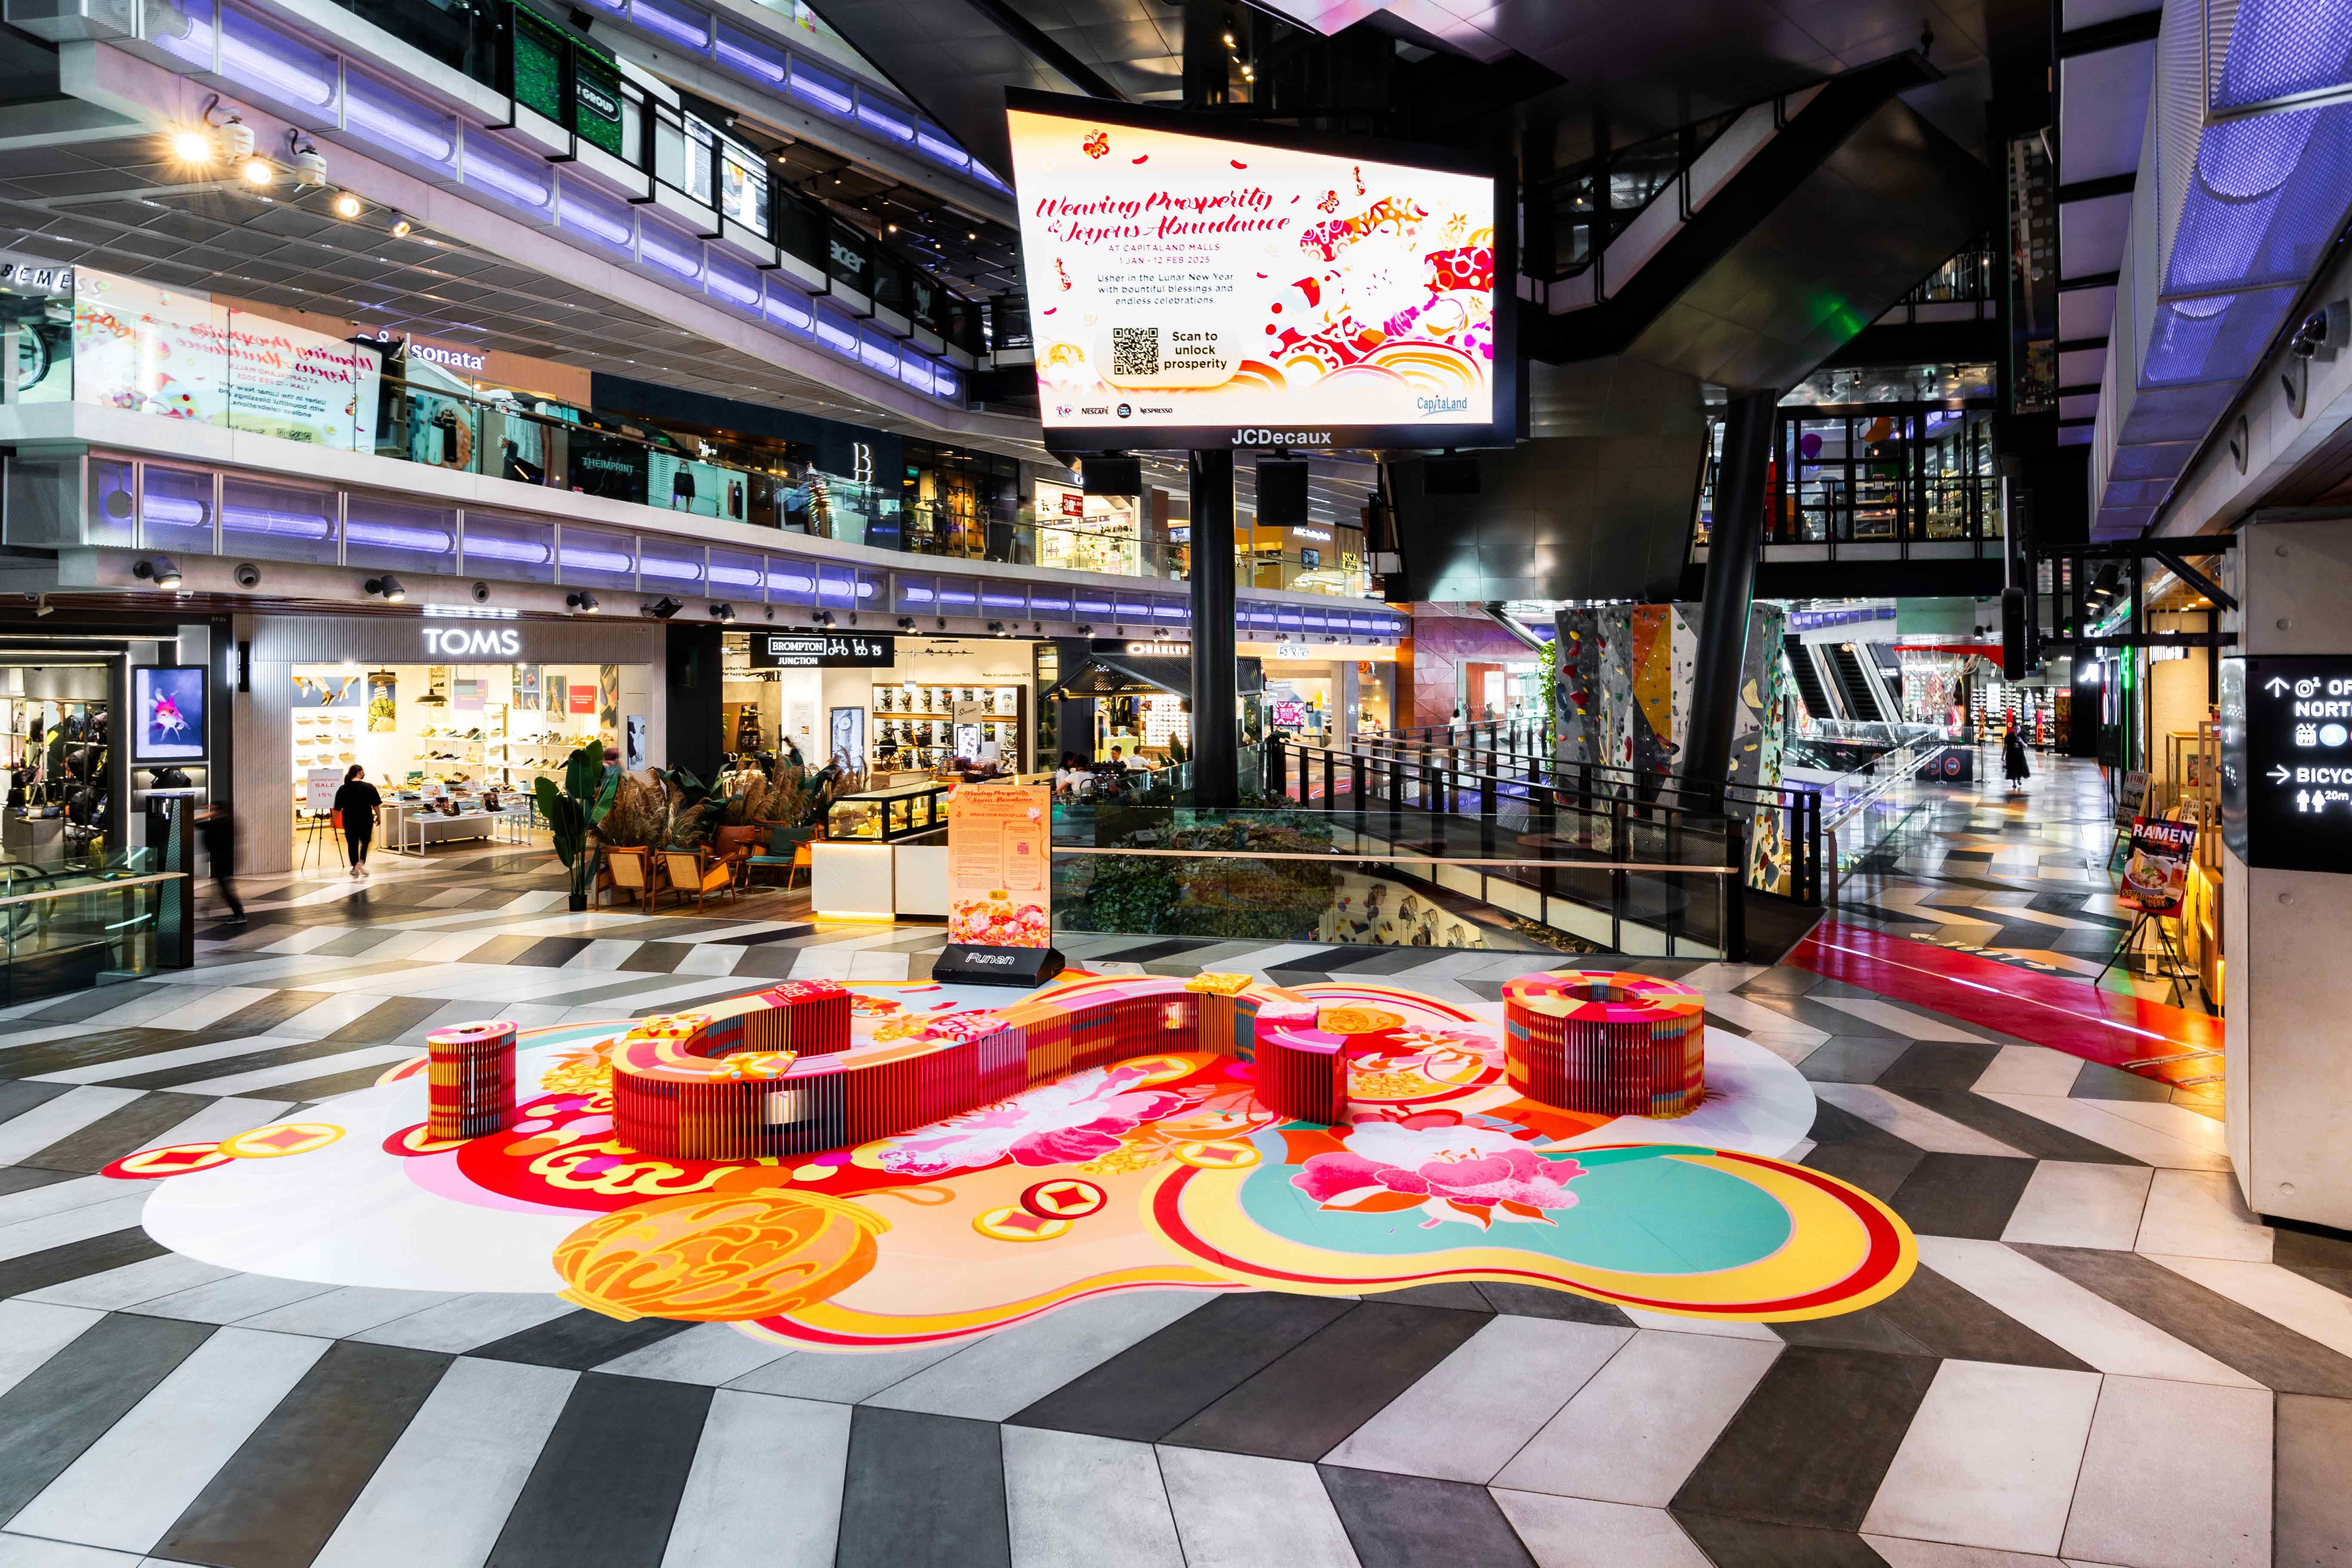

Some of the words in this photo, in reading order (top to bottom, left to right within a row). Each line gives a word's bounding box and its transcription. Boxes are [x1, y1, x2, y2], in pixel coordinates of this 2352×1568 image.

[582, 89, 614, 113] GROUP
[1036, 195, 1140, 219] Weaving
[1145, 187, 1274, 214] Prosperity
[1047, 220, 1062, 233] &
[1060, 221, 1139, 245] Joyous
[1142, 214, 1289, 239] Abundance
[830, 239, 866, 273] acer
[1122, 285, 1165, 293] bountiful
[1168, 285, 1212, 294] blessings
[1173, 332, 1200, 341] Scan
[1205, 332, 1218, 341] to
[411, 344, 485, 370] sonata
[1175, 345, 1216, 355] unlock
[1164, 358, 1227, 370] prosperity
[1418, 395, 1467, 413] CapitaLand
[1231, 429, 1331, 444] JCDecaux
[581, 457, 634, 473] THEIMPRINT
[423, 628, 520, 655] TOMS
[772, 642, 823, 651] BROMPTON
[778, 657, 818, 665] JUNCTION
[2295, 701, 2352, 717] NORT
[2324, 790, 2349, 800] 20m
[2133, 823, 2194, 845] RAMEN
[965, 952, 1015, 965] Funan
